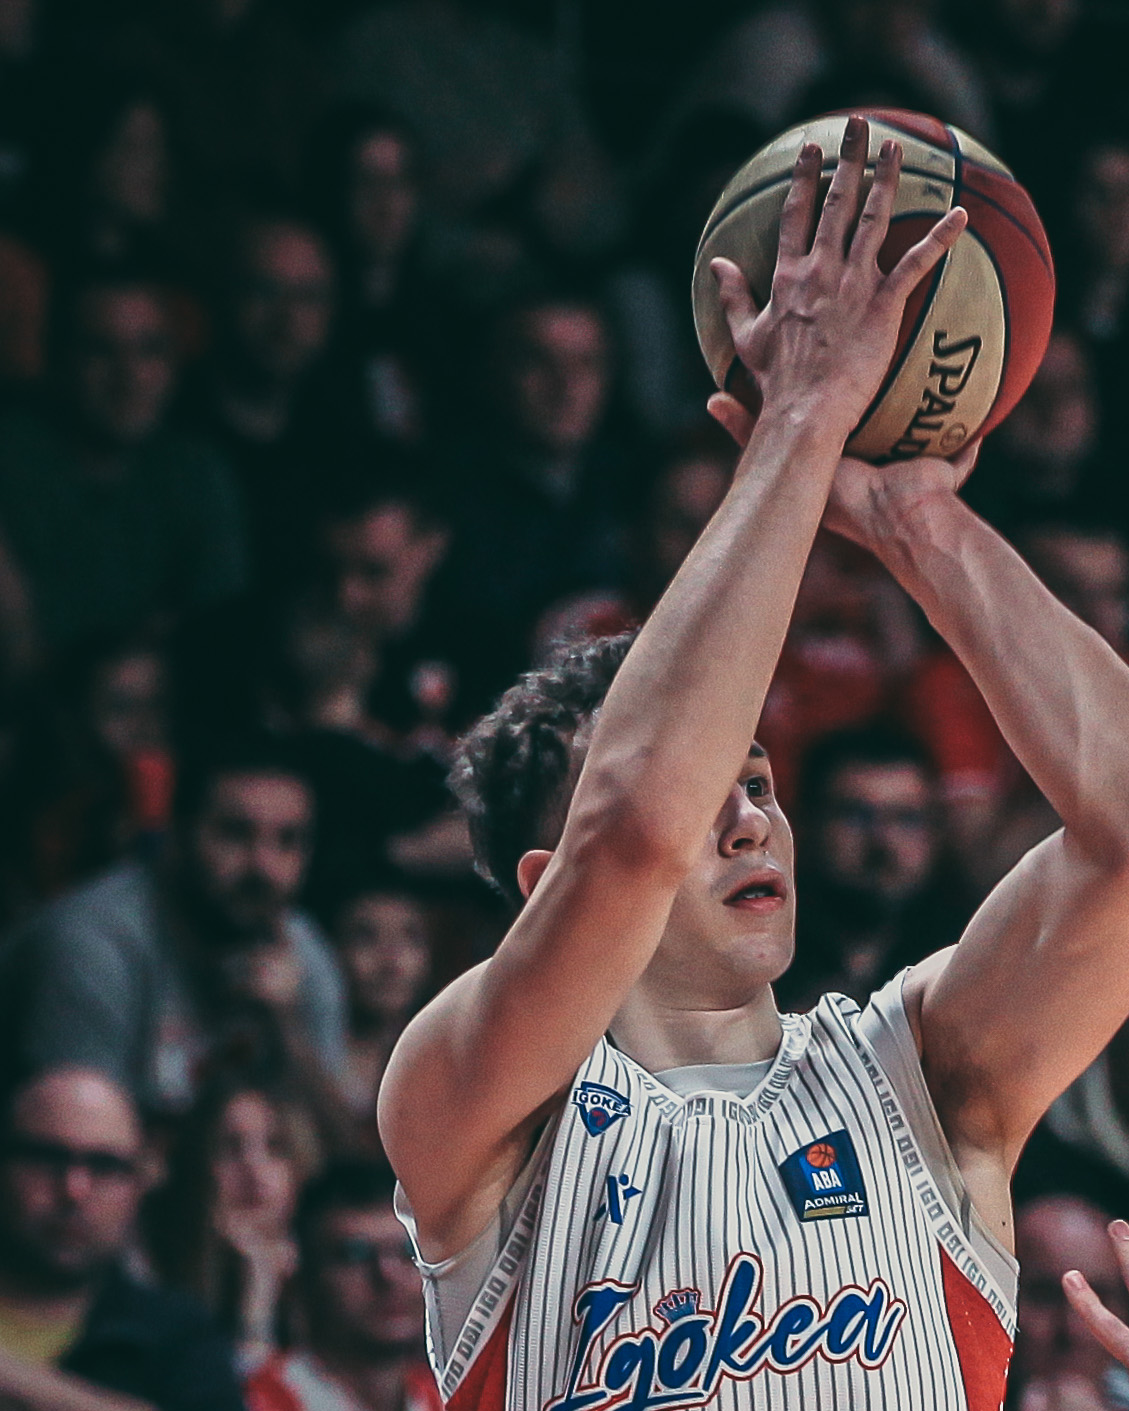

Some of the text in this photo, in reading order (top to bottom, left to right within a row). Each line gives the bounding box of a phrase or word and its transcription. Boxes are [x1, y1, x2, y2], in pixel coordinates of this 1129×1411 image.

[573, 1090, 631, 1116] IGOKEA
[811, 1167, 842, 1191] ABA
[804, 1192, 864, 1210] ADMIRAL
